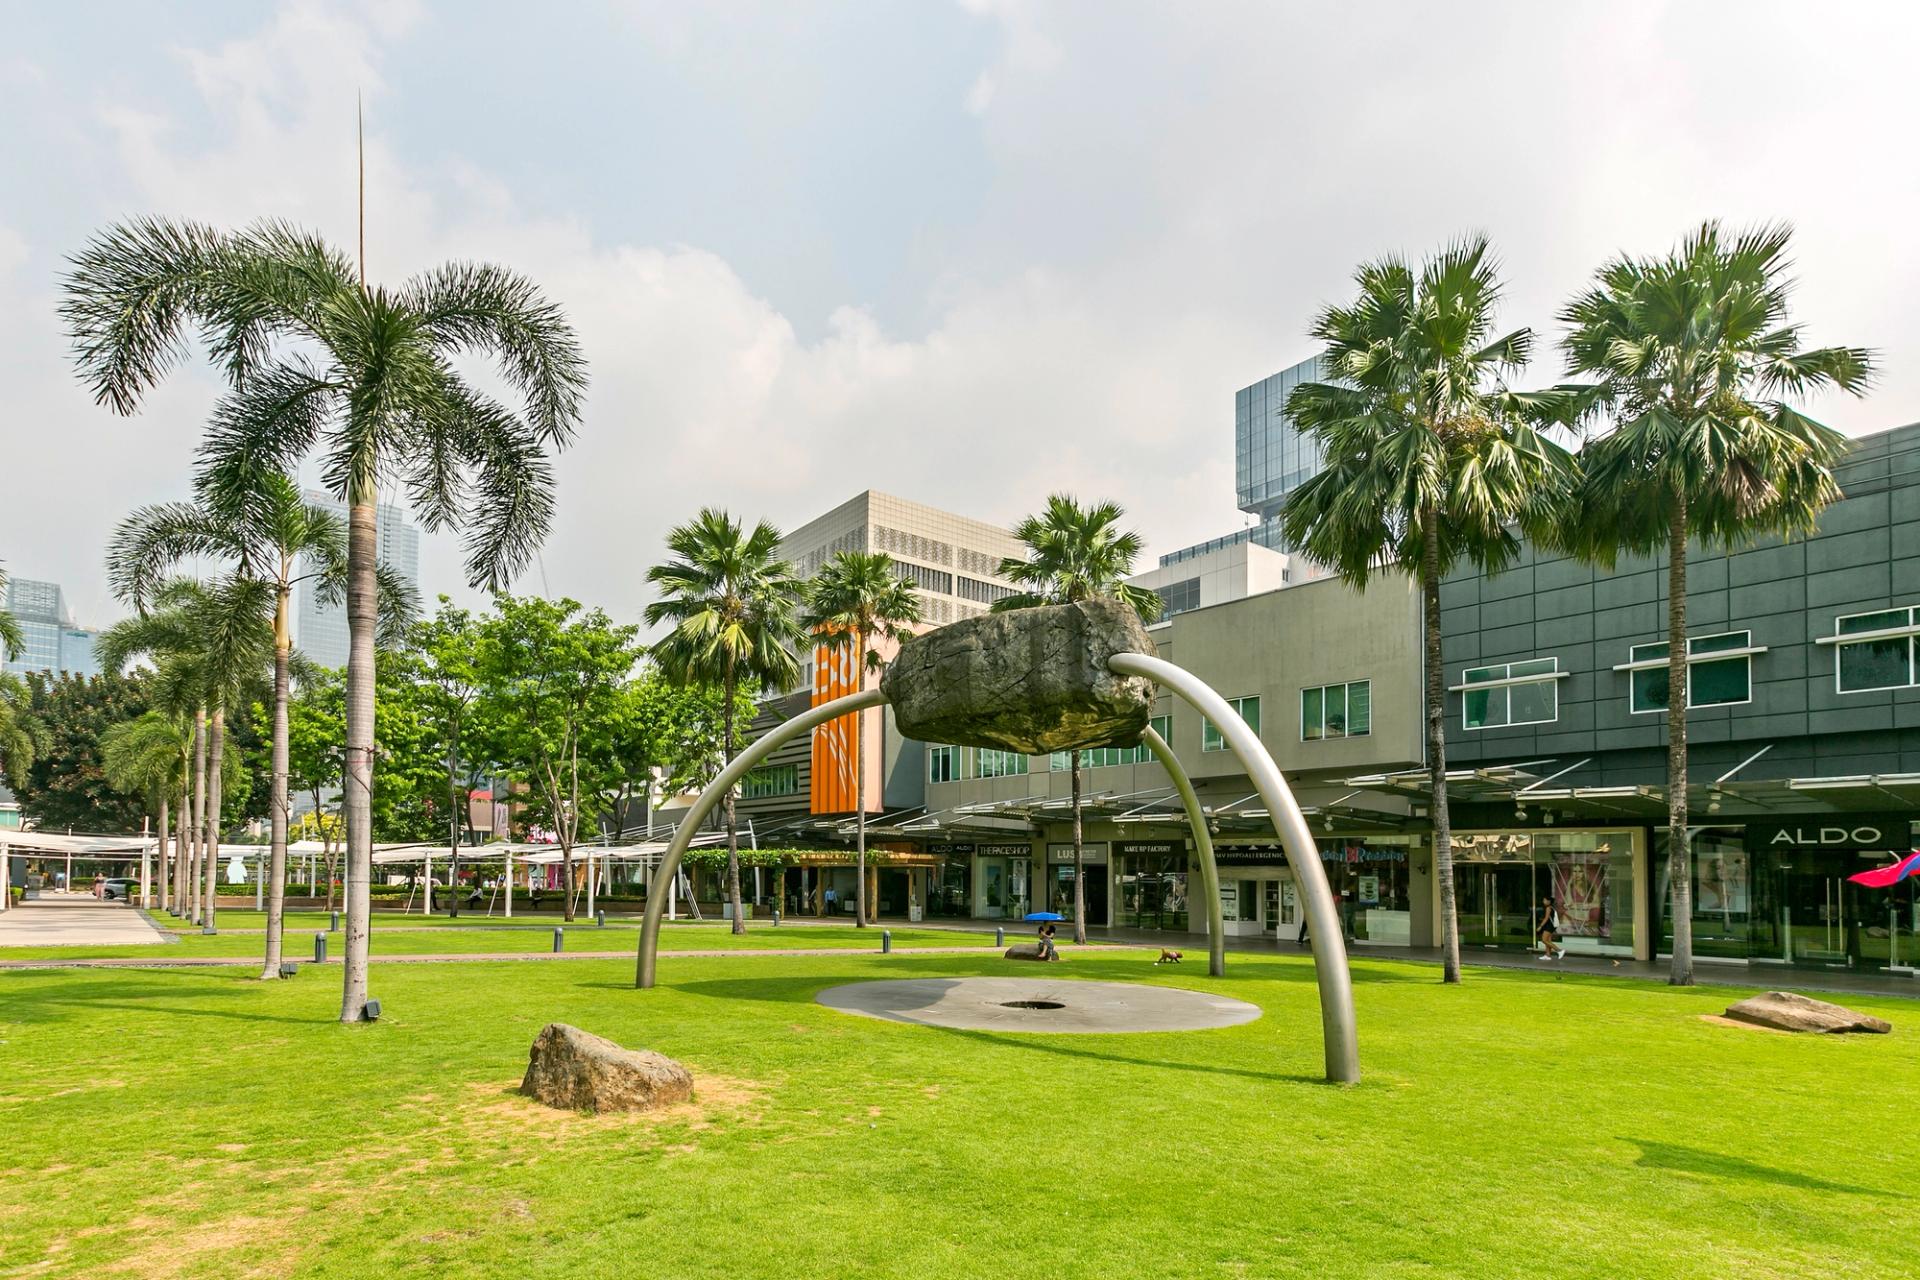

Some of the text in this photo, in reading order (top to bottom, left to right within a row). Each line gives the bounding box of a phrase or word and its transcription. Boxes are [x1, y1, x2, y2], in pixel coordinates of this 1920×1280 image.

[1770, 827, 1882, 845] ALDO
[931, 845, 953, 853] ALDO
[1057, 850, 1081, 859] LUS
